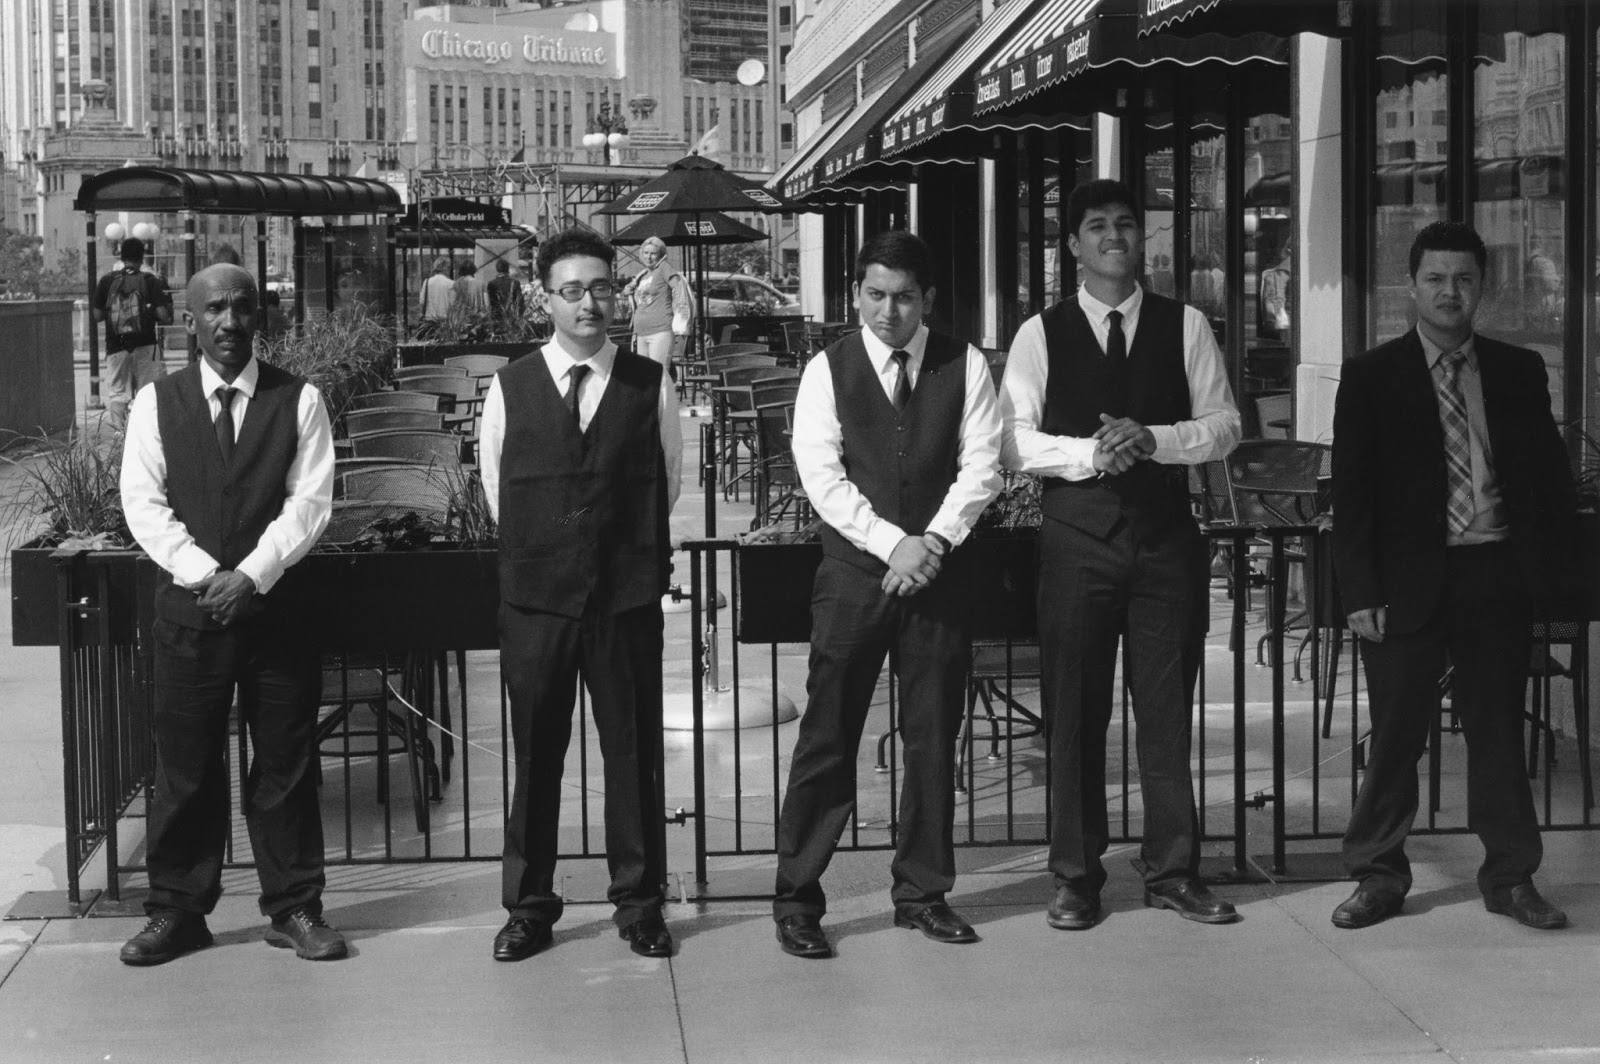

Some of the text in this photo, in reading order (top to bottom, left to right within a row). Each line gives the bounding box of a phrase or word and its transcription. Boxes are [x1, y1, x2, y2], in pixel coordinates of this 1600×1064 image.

[421, 29, 607, 65] Chicago Tribune
[441, 212, 467, 221] Cellular
[467, 212, 485, 221] Field
